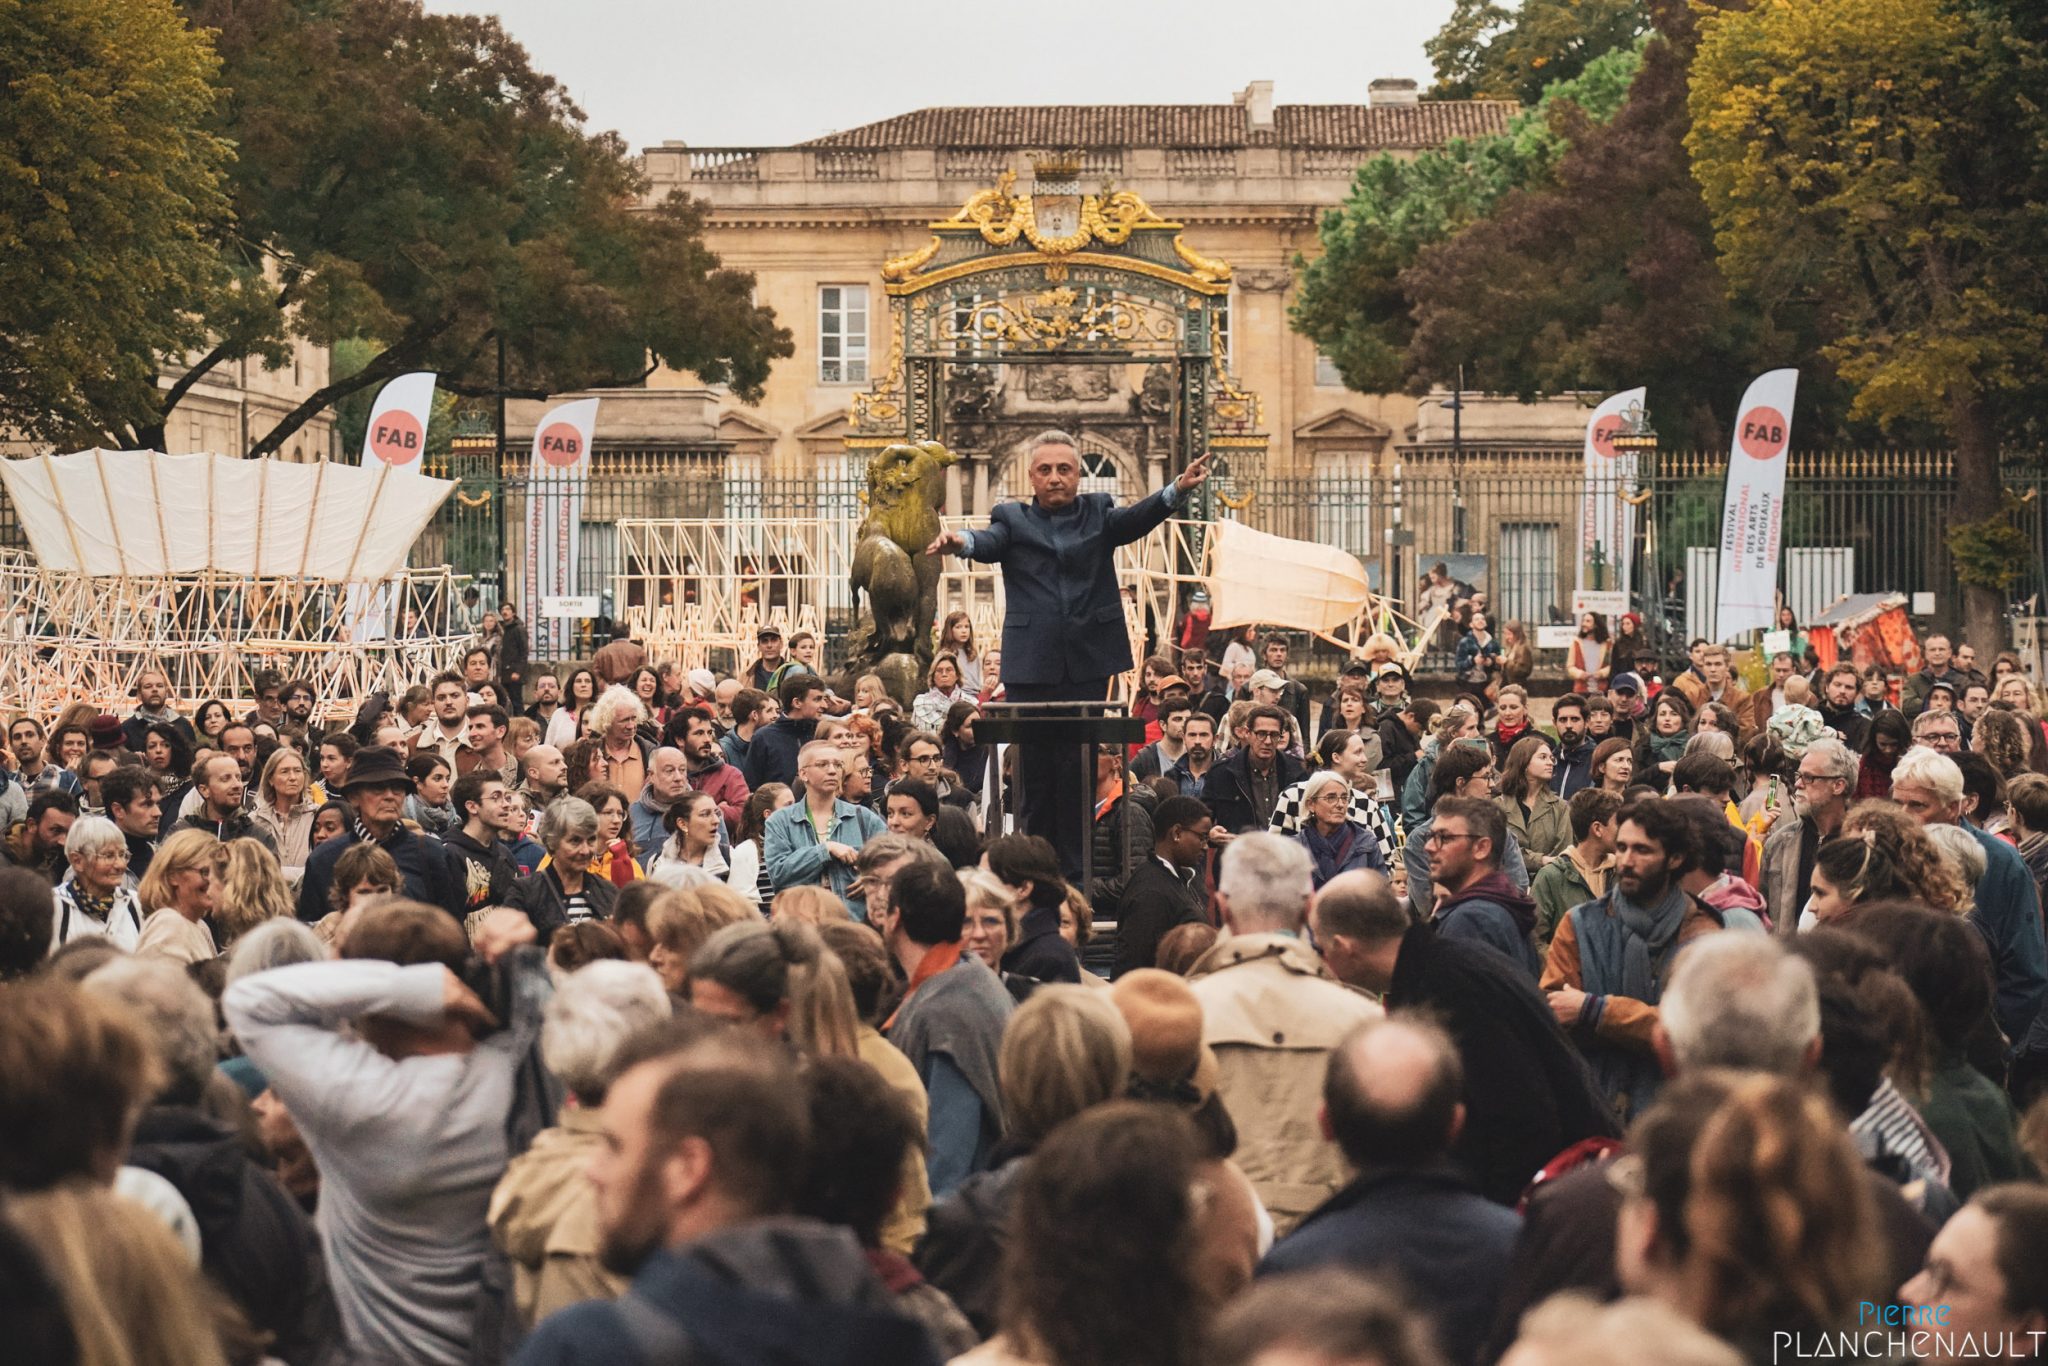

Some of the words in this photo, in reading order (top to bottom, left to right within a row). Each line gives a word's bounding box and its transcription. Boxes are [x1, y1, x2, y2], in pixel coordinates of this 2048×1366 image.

[376, 426, 418, 449] FAB
[1743, 422, 1782, 444] FAB
[543, 436, 577, 454] FAB
[1725, 503, 1737, 551] FESTIVAL
[1733, 484, 1750, 573] INTERNATIONAL
[1748, 504, 1759, 531] ARTS
[1757, 492, 1770, 553] BORDEAUX
[1746, 534, 1756, 554] DES
[1756, 556, 1765, 569] DE
